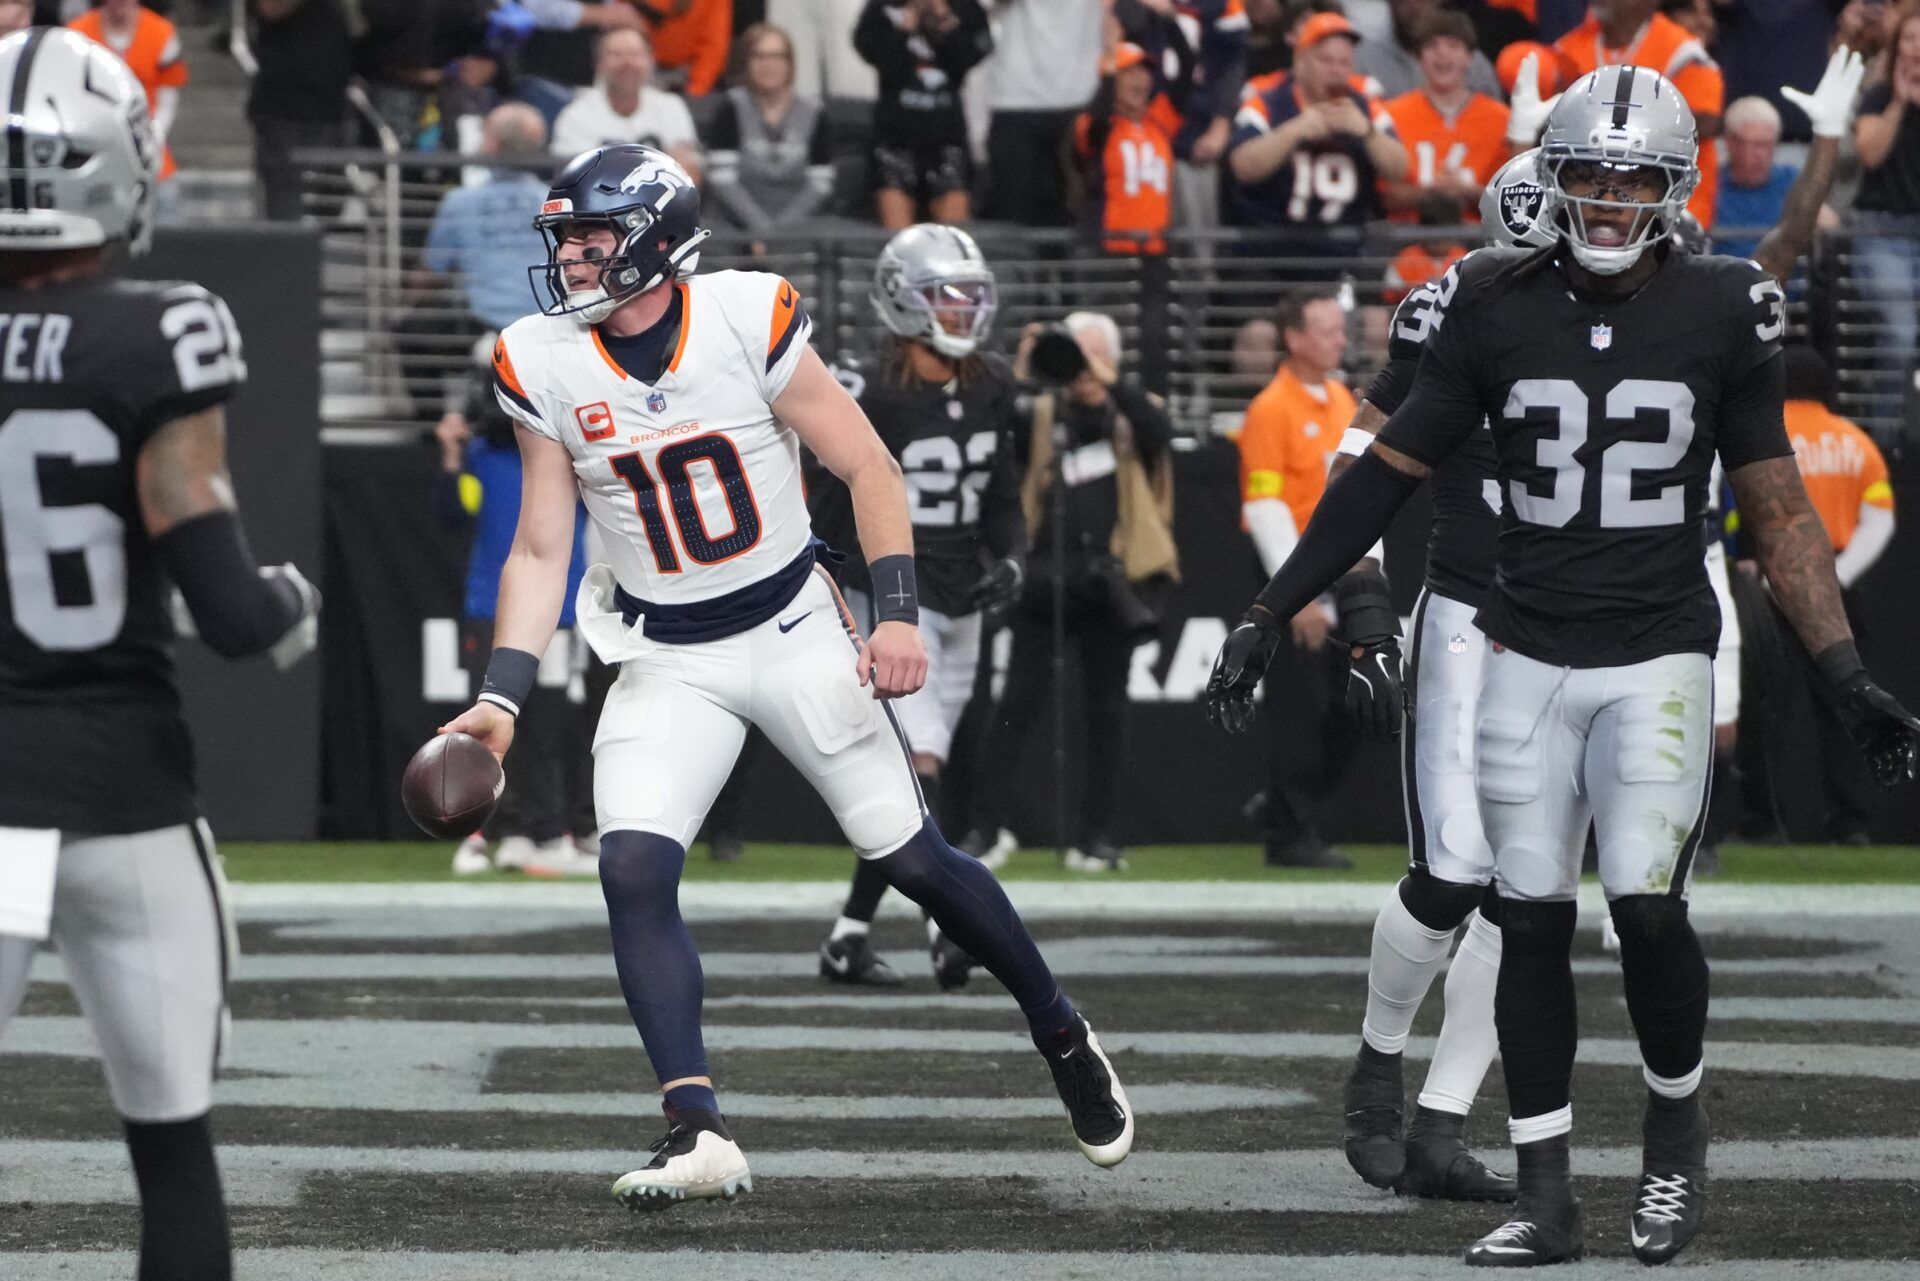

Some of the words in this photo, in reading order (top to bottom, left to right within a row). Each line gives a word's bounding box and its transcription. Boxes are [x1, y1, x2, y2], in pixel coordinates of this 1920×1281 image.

[1119, 139, 1169, 197] 14
[1287, 150, 1358, 222] 19
[1504, 186, 1541, 195] RAIDERS
[579, 405, 610, 432] C
[630, 421, 700, 445] BRONCOS
[1503, 378, 1696, 529] 32
[607, 431, 763, 574] 10
